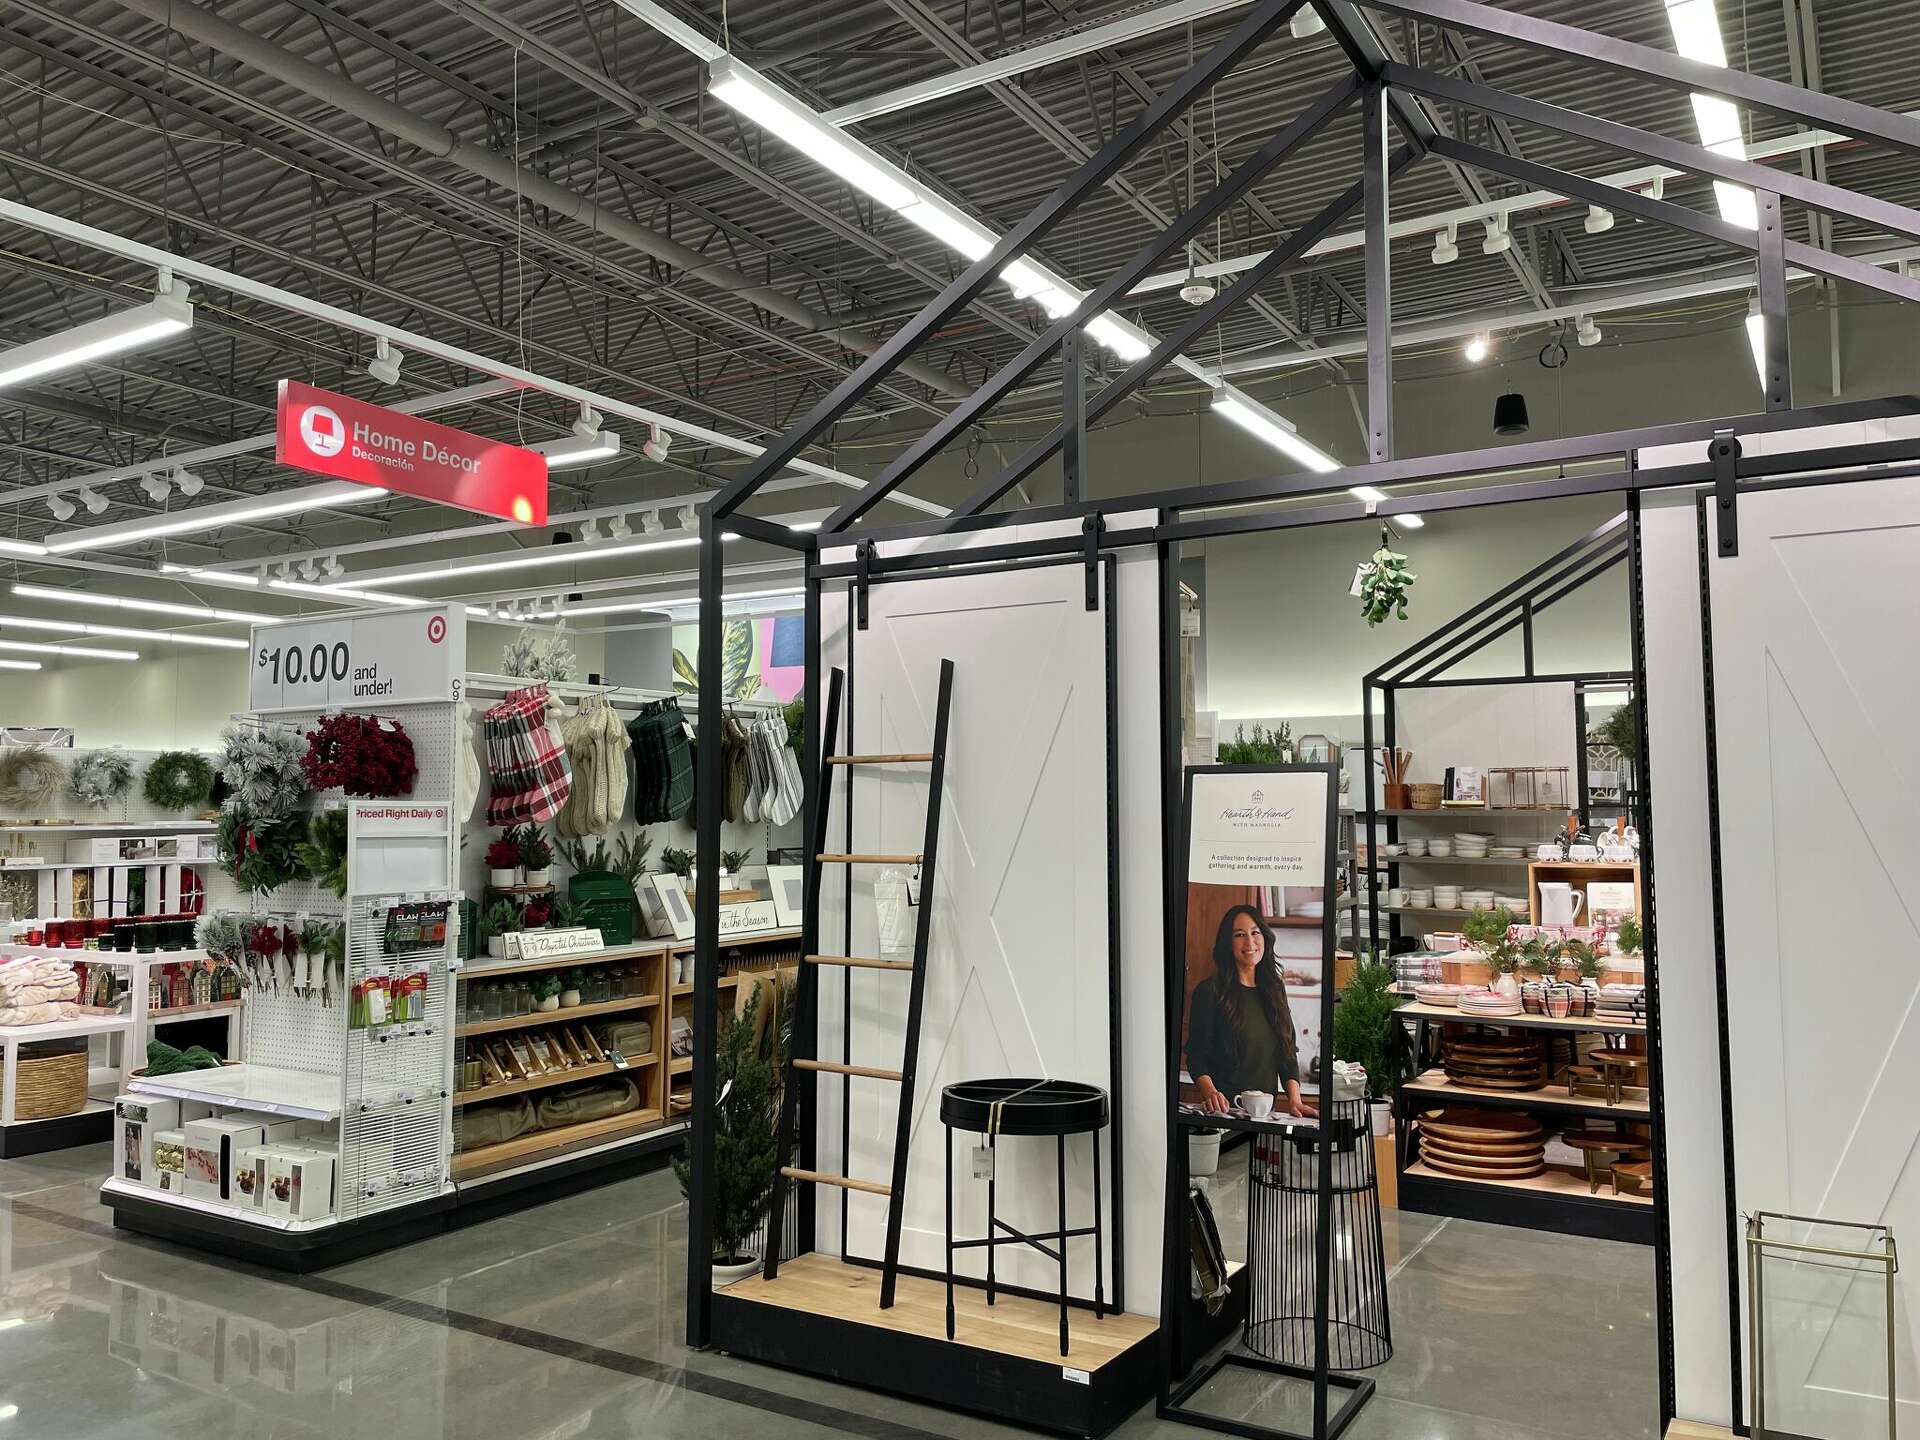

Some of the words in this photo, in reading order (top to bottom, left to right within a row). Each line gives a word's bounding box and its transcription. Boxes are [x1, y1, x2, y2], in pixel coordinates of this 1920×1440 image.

[353, 421, 416, 456] Home
[422, 440, 481, 473] Décor
[352, 446, 415, 472] Decoración
[258, 641, 350, 684] $10.00
[354, 663, 377, 681] and
[354, 678, 393, 696] under!
[452, 679, 461, 690] C
[452, 690, 460, 701] 9
[356, 809, 384, 818] Priced
[385, 809, 410, 819] Right
[411, 809, 433, 819] Daily
[1208, 862, 1235, 870] gathering
[1246, 855, 1272, 863] designed
[742, 906, 769, 926] Season
